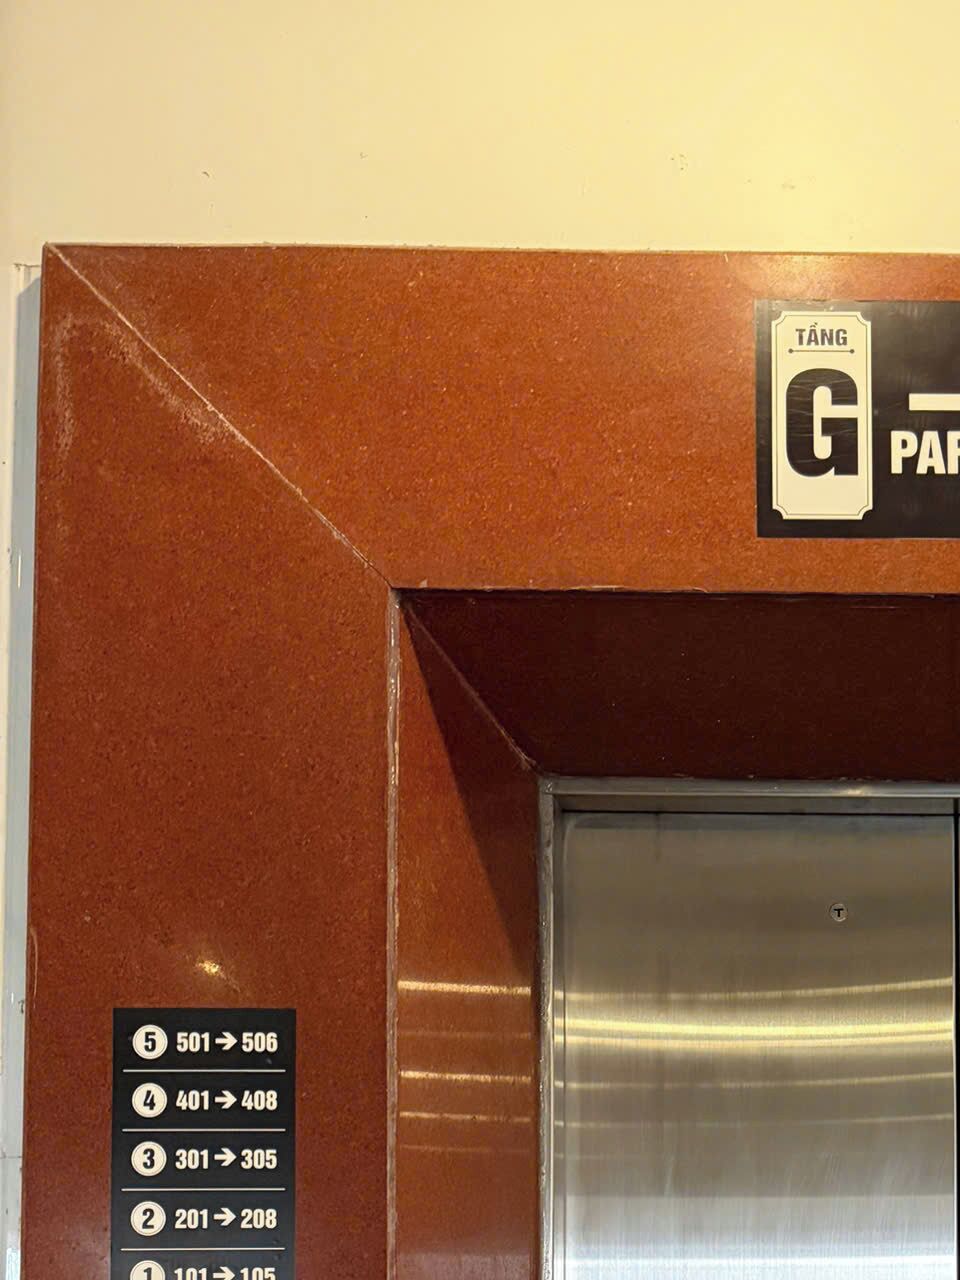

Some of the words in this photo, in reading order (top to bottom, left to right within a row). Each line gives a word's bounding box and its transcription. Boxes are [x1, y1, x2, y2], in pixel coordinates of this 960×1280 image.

[795, 322, 848, 347] TẦNG
[786, 368, 859, 477] G
[143, 1031, 157, 1051] 5
[176, 1032, 210, 1052] 501
[241, 1032, 278, 1052] 506
[142, 1090, 156, 1110] 4
[175, 1090, 210, 1111] 401
[241, 1090, 278, 1111] 408
[142, 1148, 155, 1169] 3
[175, 1149, 209, 1170] 301
[240, 1149, 277, 1170] 305
[142, 1208, 155, 1229] 2
[174, 1209, 209, 1229] 201
[240, 1209, 277, 1229] 208
